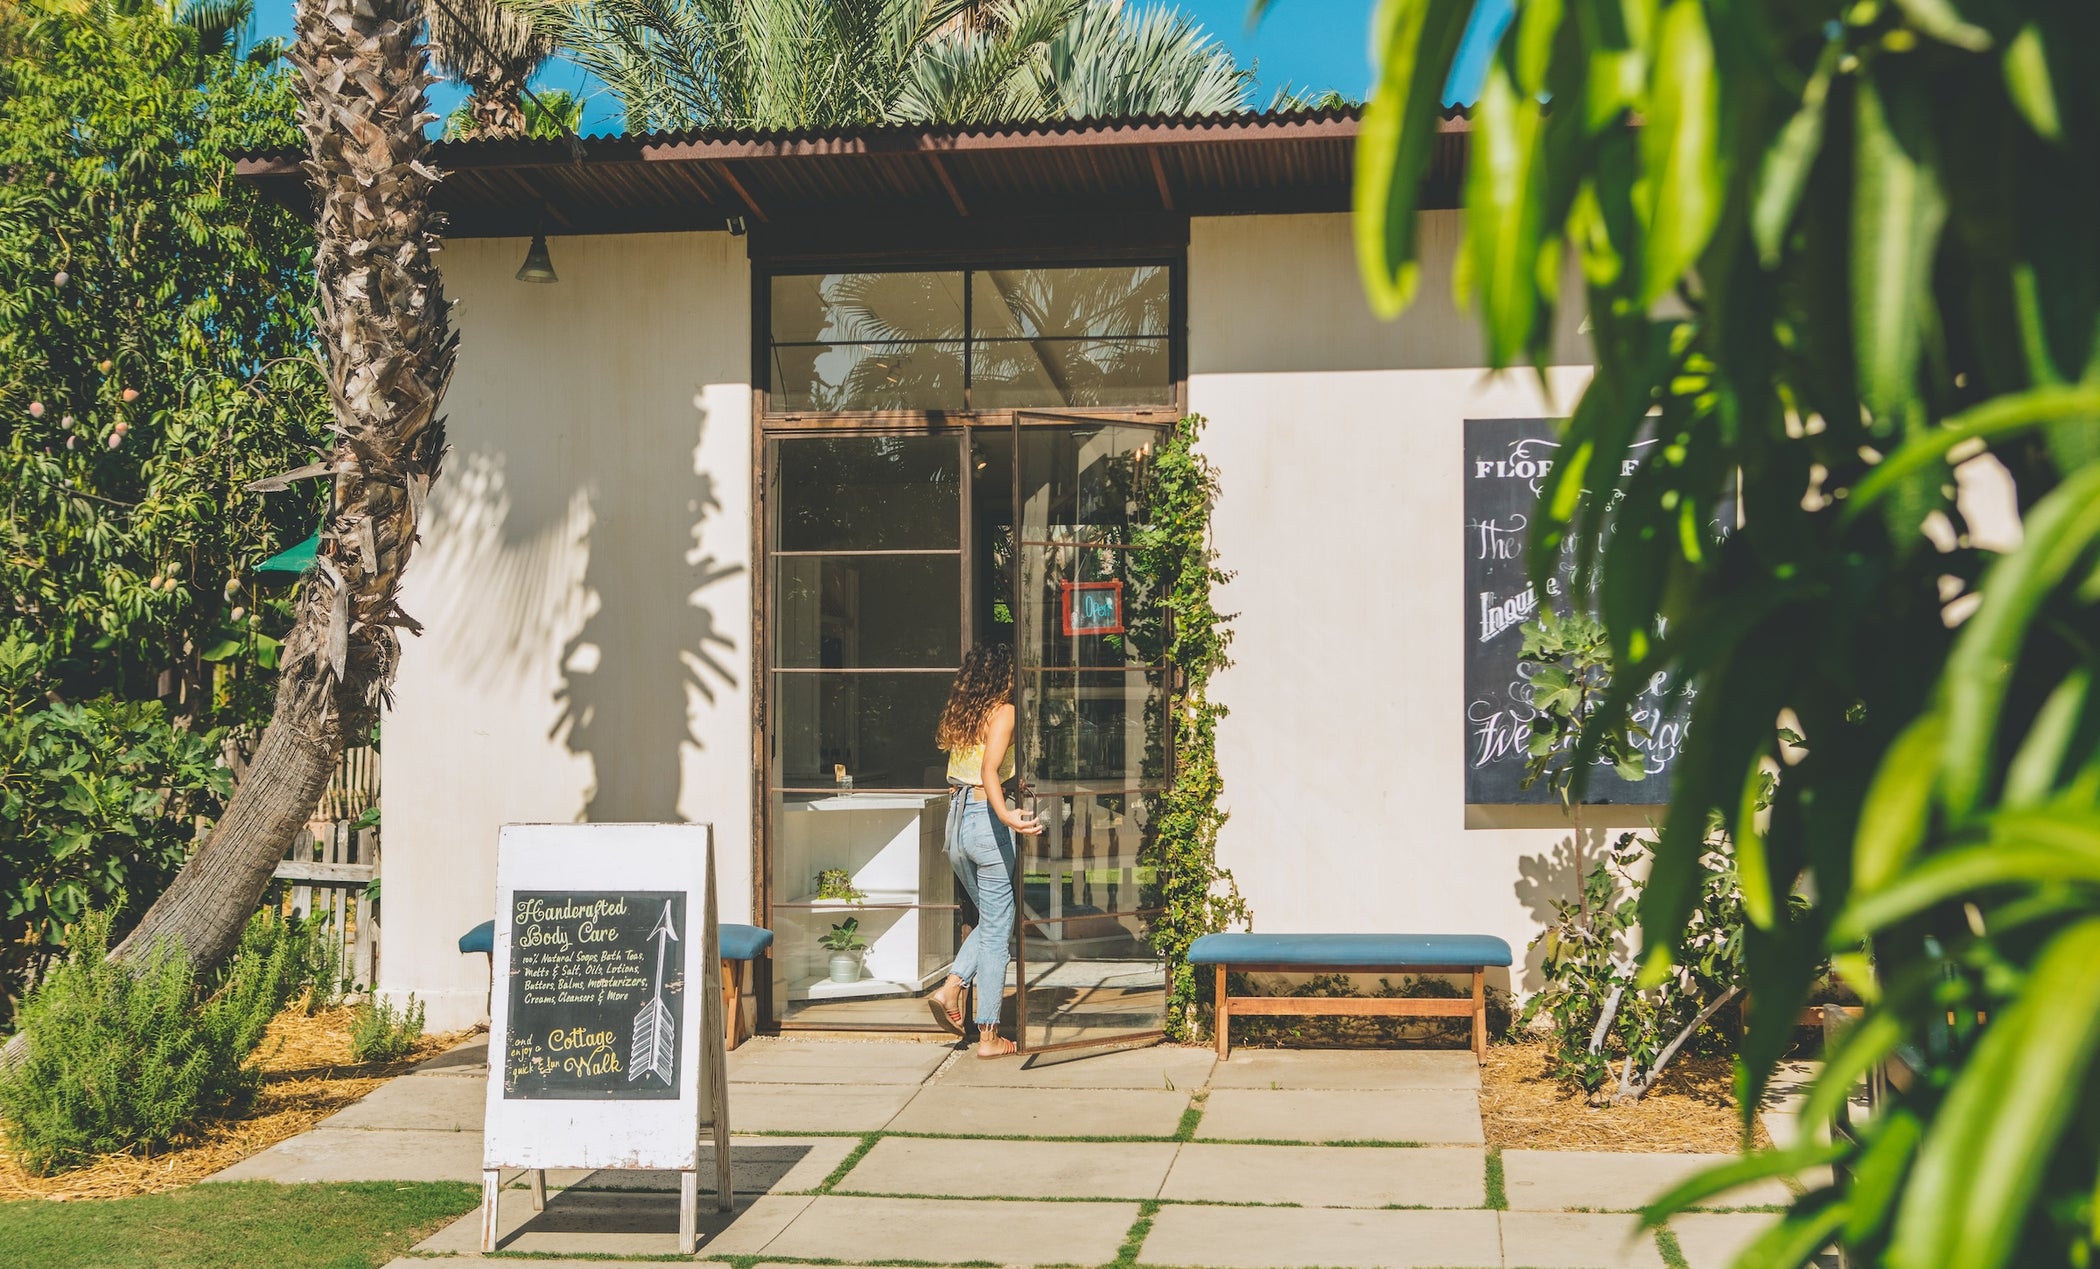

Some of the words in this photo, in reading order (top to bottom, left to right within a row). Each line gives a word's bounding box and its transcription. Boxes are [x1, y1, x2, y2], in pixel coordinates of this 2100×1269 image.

[1466, 513, 1528, 560] The
[1479, 577, 1562, 643] Inquie
[515, 896, 628, 925] Handcrafted
[519, 924, 573, 953] Body
[578, 921, 619, 943] Care
[540, 951, 576, 964] Natural
[600, 950, 622, 963] Bath
[552, 963, 560, 980] &
[561, 964, 582, 977] Salt,
[605, 962, 640, 974] Lotions,
[524, 979, 556, 991] Butters,
[557, 977, 585, 991] Balms,
[524, 992, 557, 1006] Creams,
[557, 991, 595, 1003] Cleansers
[597, 988, 605, 1006] &
[606, 989, 629, 1001] More
[514, 1033, 533, 1047] and
[547, 1027, 617, 1053] Cottage
[510, 1045, 533, 1063] enjoy
[534, 1045, 542, 1053] a
[563, 1044, 624, 1078] Walk
[512, 1061, 534, 1085] quick
